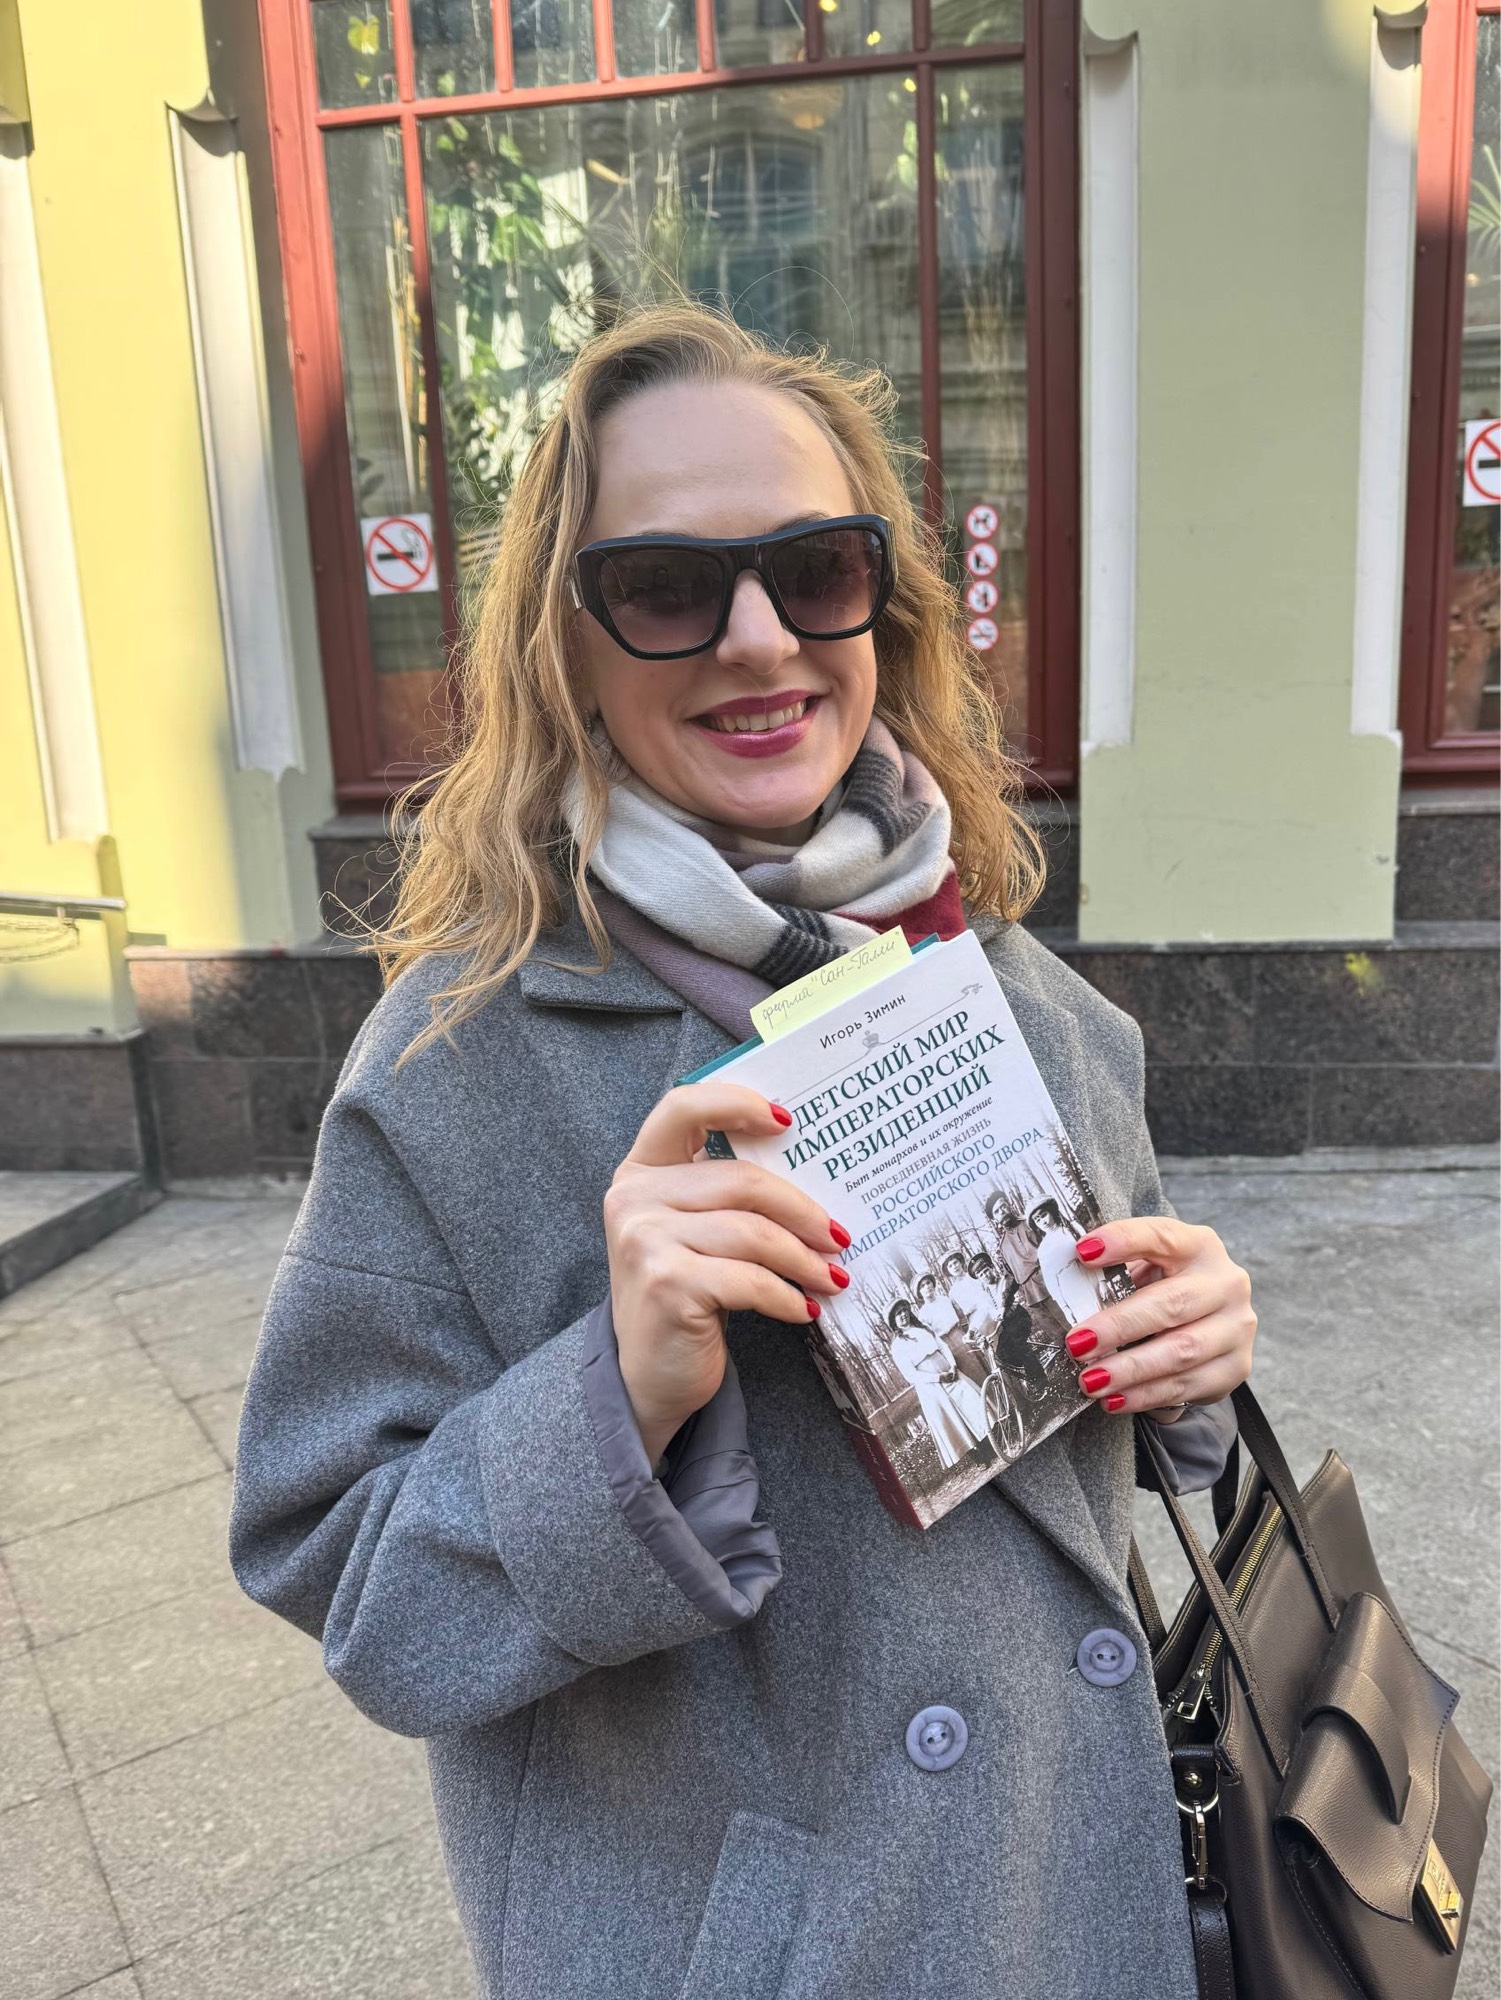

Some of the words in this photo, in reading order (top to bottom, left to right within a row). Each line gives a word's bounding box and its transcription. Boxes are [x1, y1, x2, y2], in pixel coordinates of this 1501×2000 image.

[762, 987, 813, 1029] фирма
[820, 1021, 862, 1049] Игорь
[864, 995, 906, 1023] Зимин
[782, 1024, 1006, 1171] ИМПЕРАТОРСКИХ
[791, 1042, 915, 1135] ДЕТСКИЙ
[914, 1010, 969, 1057] МИР
[822, 1063, 992, 1182] РЕЗИДЕНЦИЙ
[845, 1173, 871, 1193] Быт
[871, 1143, 919, 1177] монархов
[920, 1136, 928, 1148] и
[928, 1127, 942, 1143] их
[942, 1096, 993, 1133] окружение
[861, 1142, 956, 1204] ПОВСЕДНЕВНАЯ
[953, 1118, 992, 1150] ЖИЗНЬ
[839, 1160, 990, 1266] ИМПЕРАТОРСКОГО
[991, 1127, 1044, 1170] ДВОРА
[871, 1134, 996, 1220] РОССИЙСКОГО
